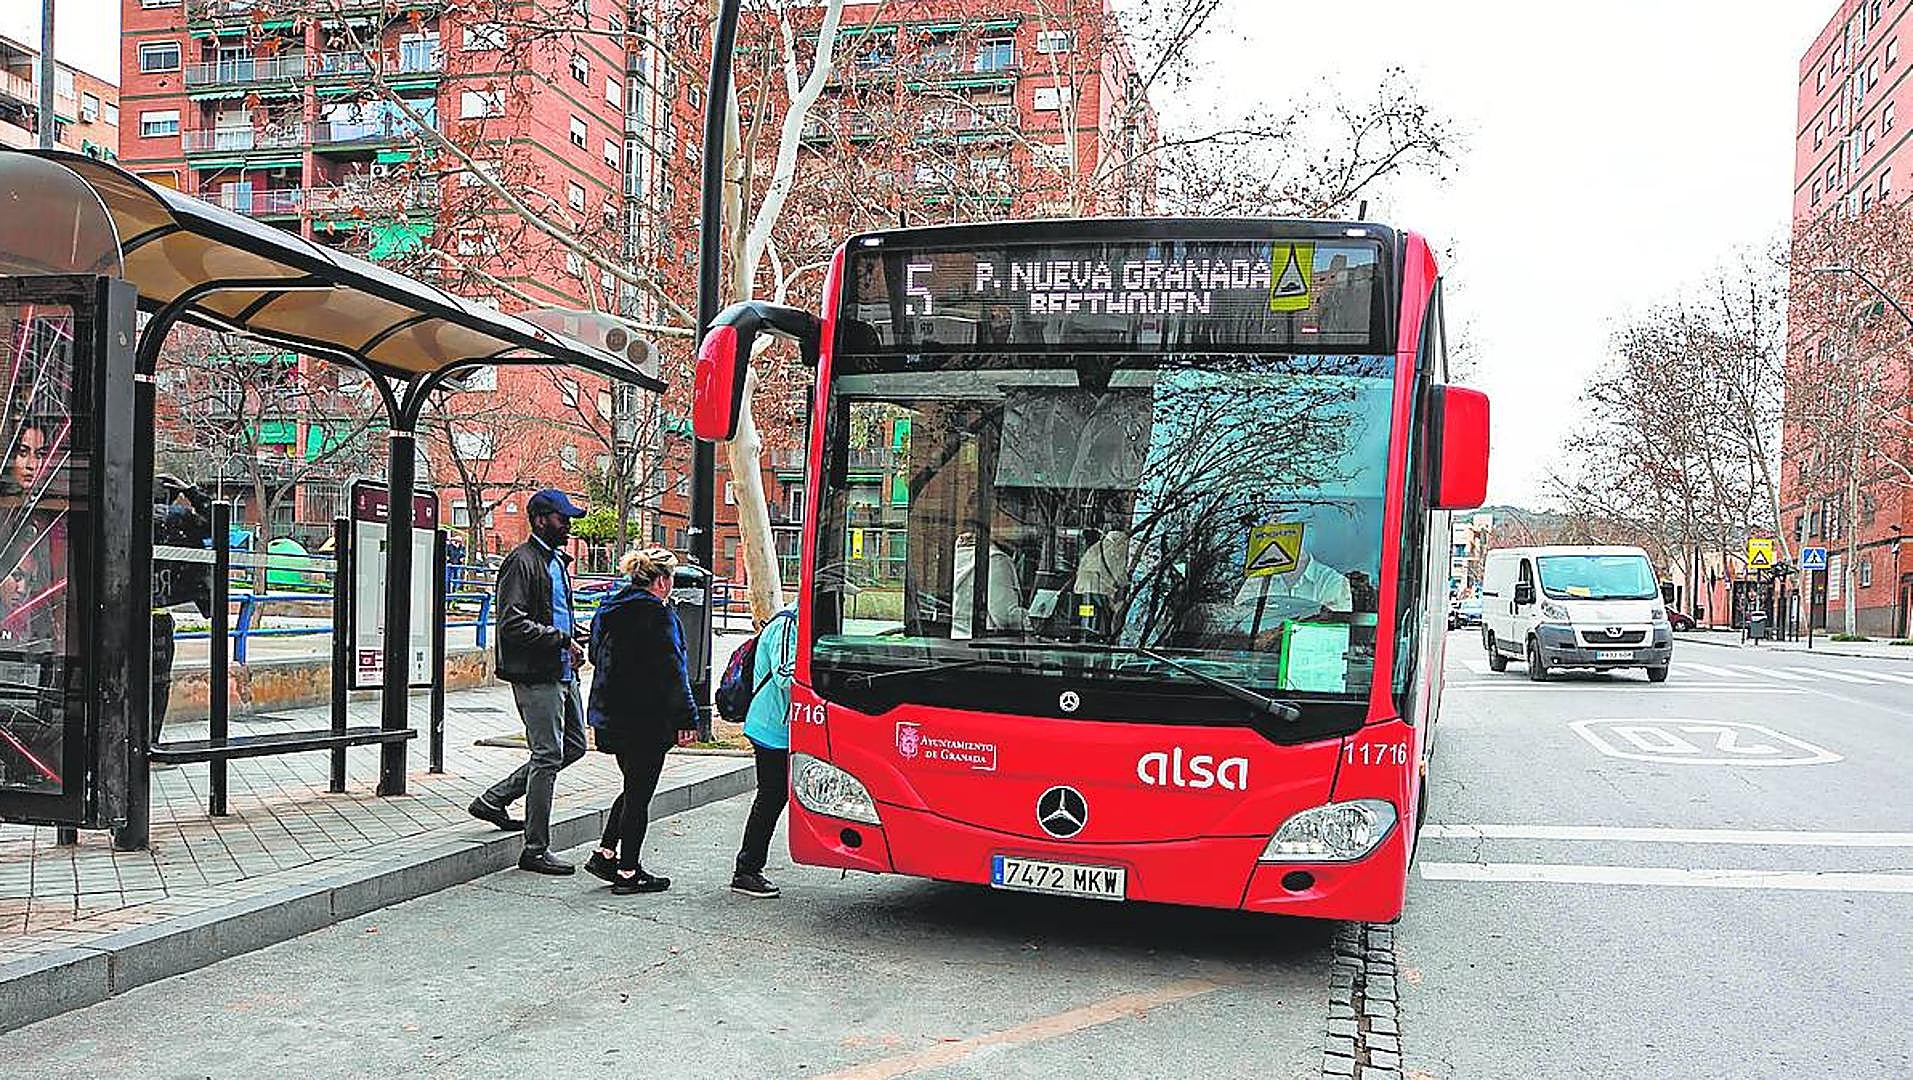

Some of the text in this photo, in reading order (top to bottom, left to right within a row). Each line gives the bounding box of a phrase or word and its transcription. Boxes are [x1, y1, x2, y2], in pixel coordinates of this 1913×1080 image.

[905, 264, 933, 315] 5
[975, 257, 1271, 292] P. NUEVA GRANADA
[940, 749, 986, 763] GRANADA
[1136, 745, 1249, 791] alsa
[1343, 742, 1407, 765] 11716
[1007, 862, 1118, 893] 7472 MKW
